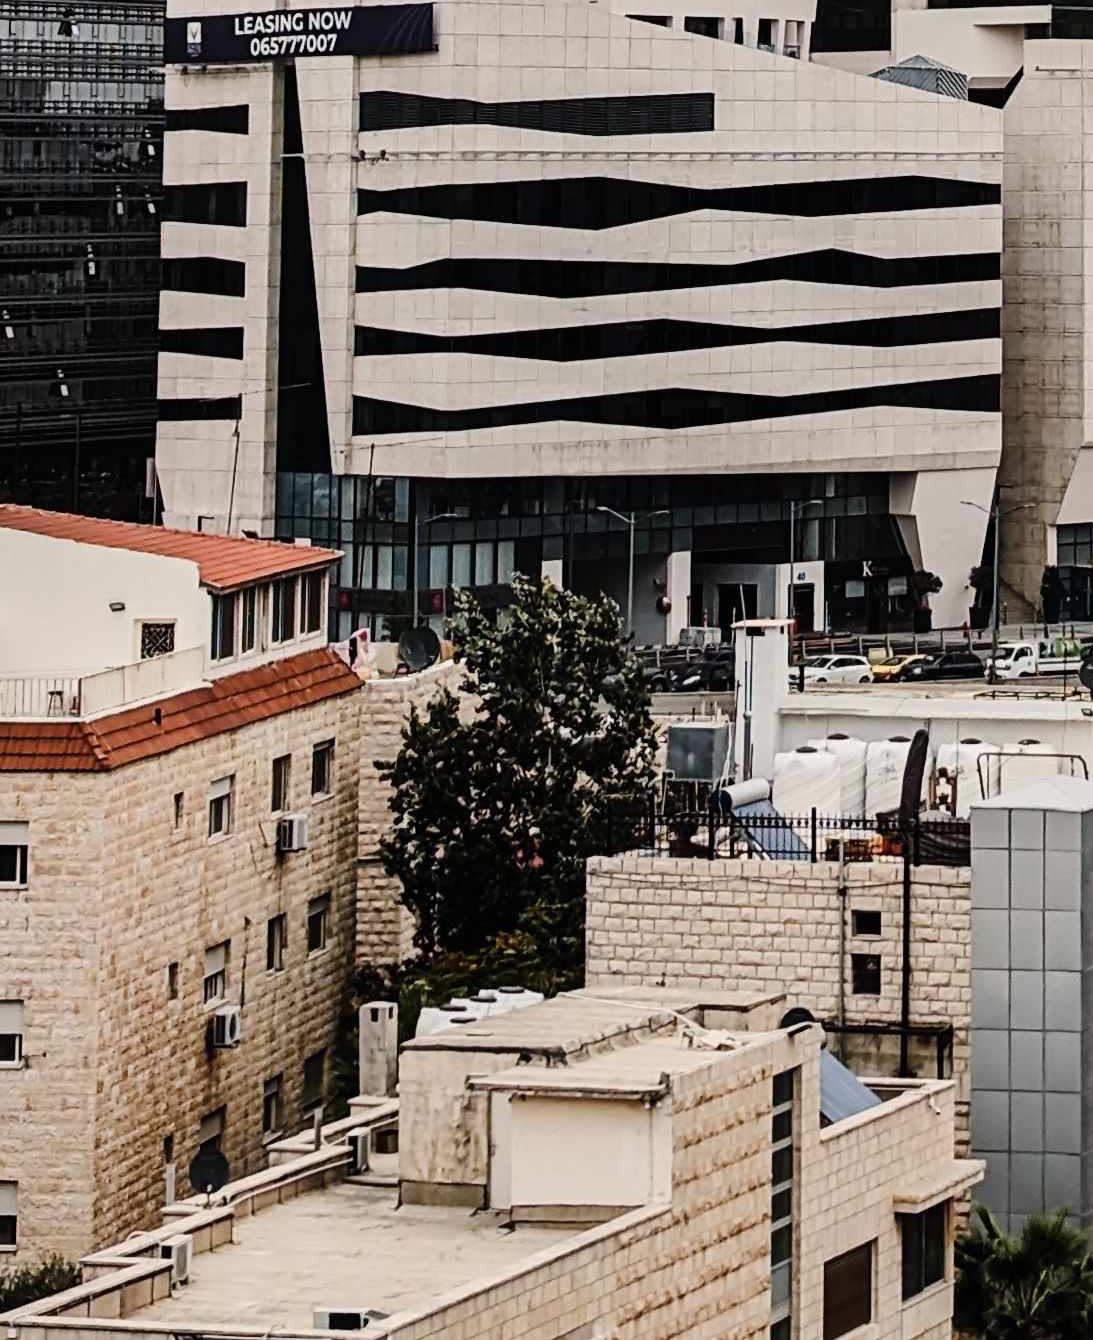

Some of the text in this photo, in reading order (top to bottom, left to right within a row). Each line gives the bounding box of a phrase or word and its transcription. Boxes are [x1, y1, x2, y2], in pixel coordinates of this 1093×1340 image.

[234, 10, 353, 36] LEASING NOW
[250, 33, 337, 56] 065777007
[862, 560, 873, 578] K
